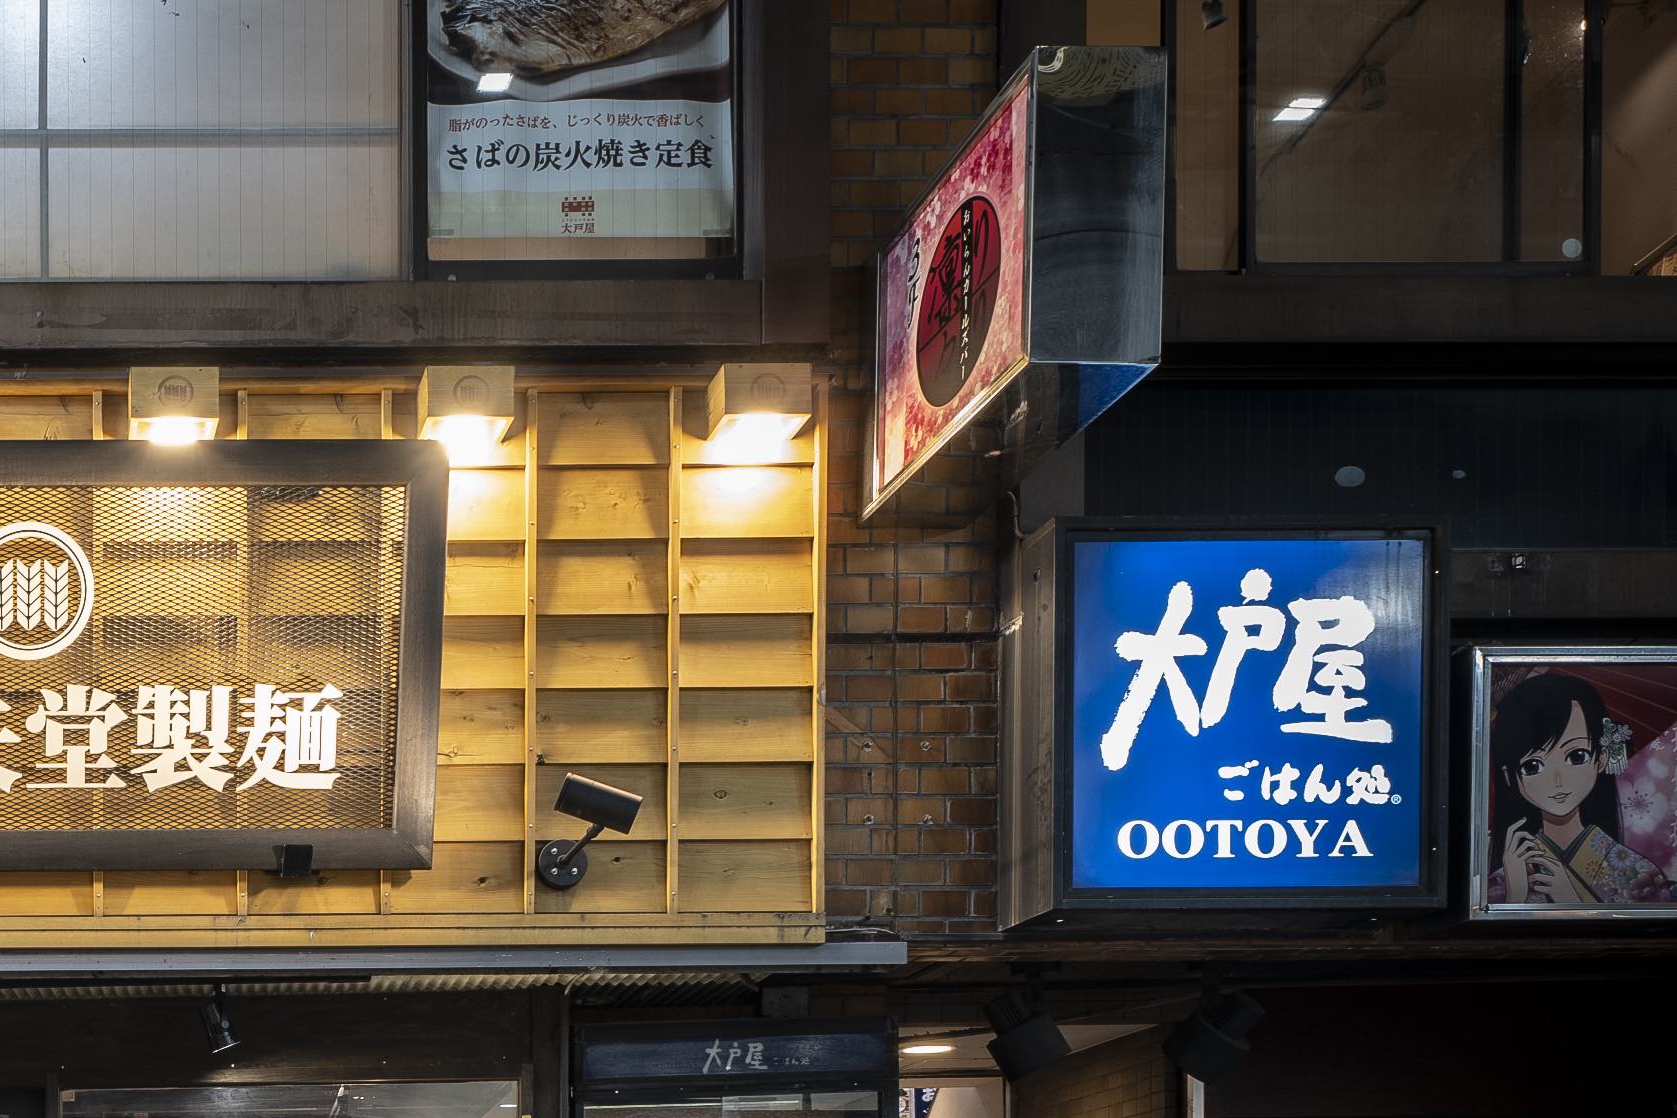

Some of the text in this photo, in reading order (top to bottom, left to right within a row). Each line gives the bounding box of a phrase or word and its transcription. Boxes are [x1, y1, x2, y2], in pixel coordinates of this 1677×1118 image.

[448, 112, 705, 133] 脂がのったさばを、じっくり炭火で香ばしく
[446, 138, 714, 172] さばの炭火焼き定食
[560, 222, 596, 235] 大戸屋
[1100, 568, 1393, 772] 大戸屋
[1217, 759, 1393, 805] ごはん処
[1116, 819, 1374, 860] OOTOYA
[702, 1038, 768, 1074] 大戸屋
